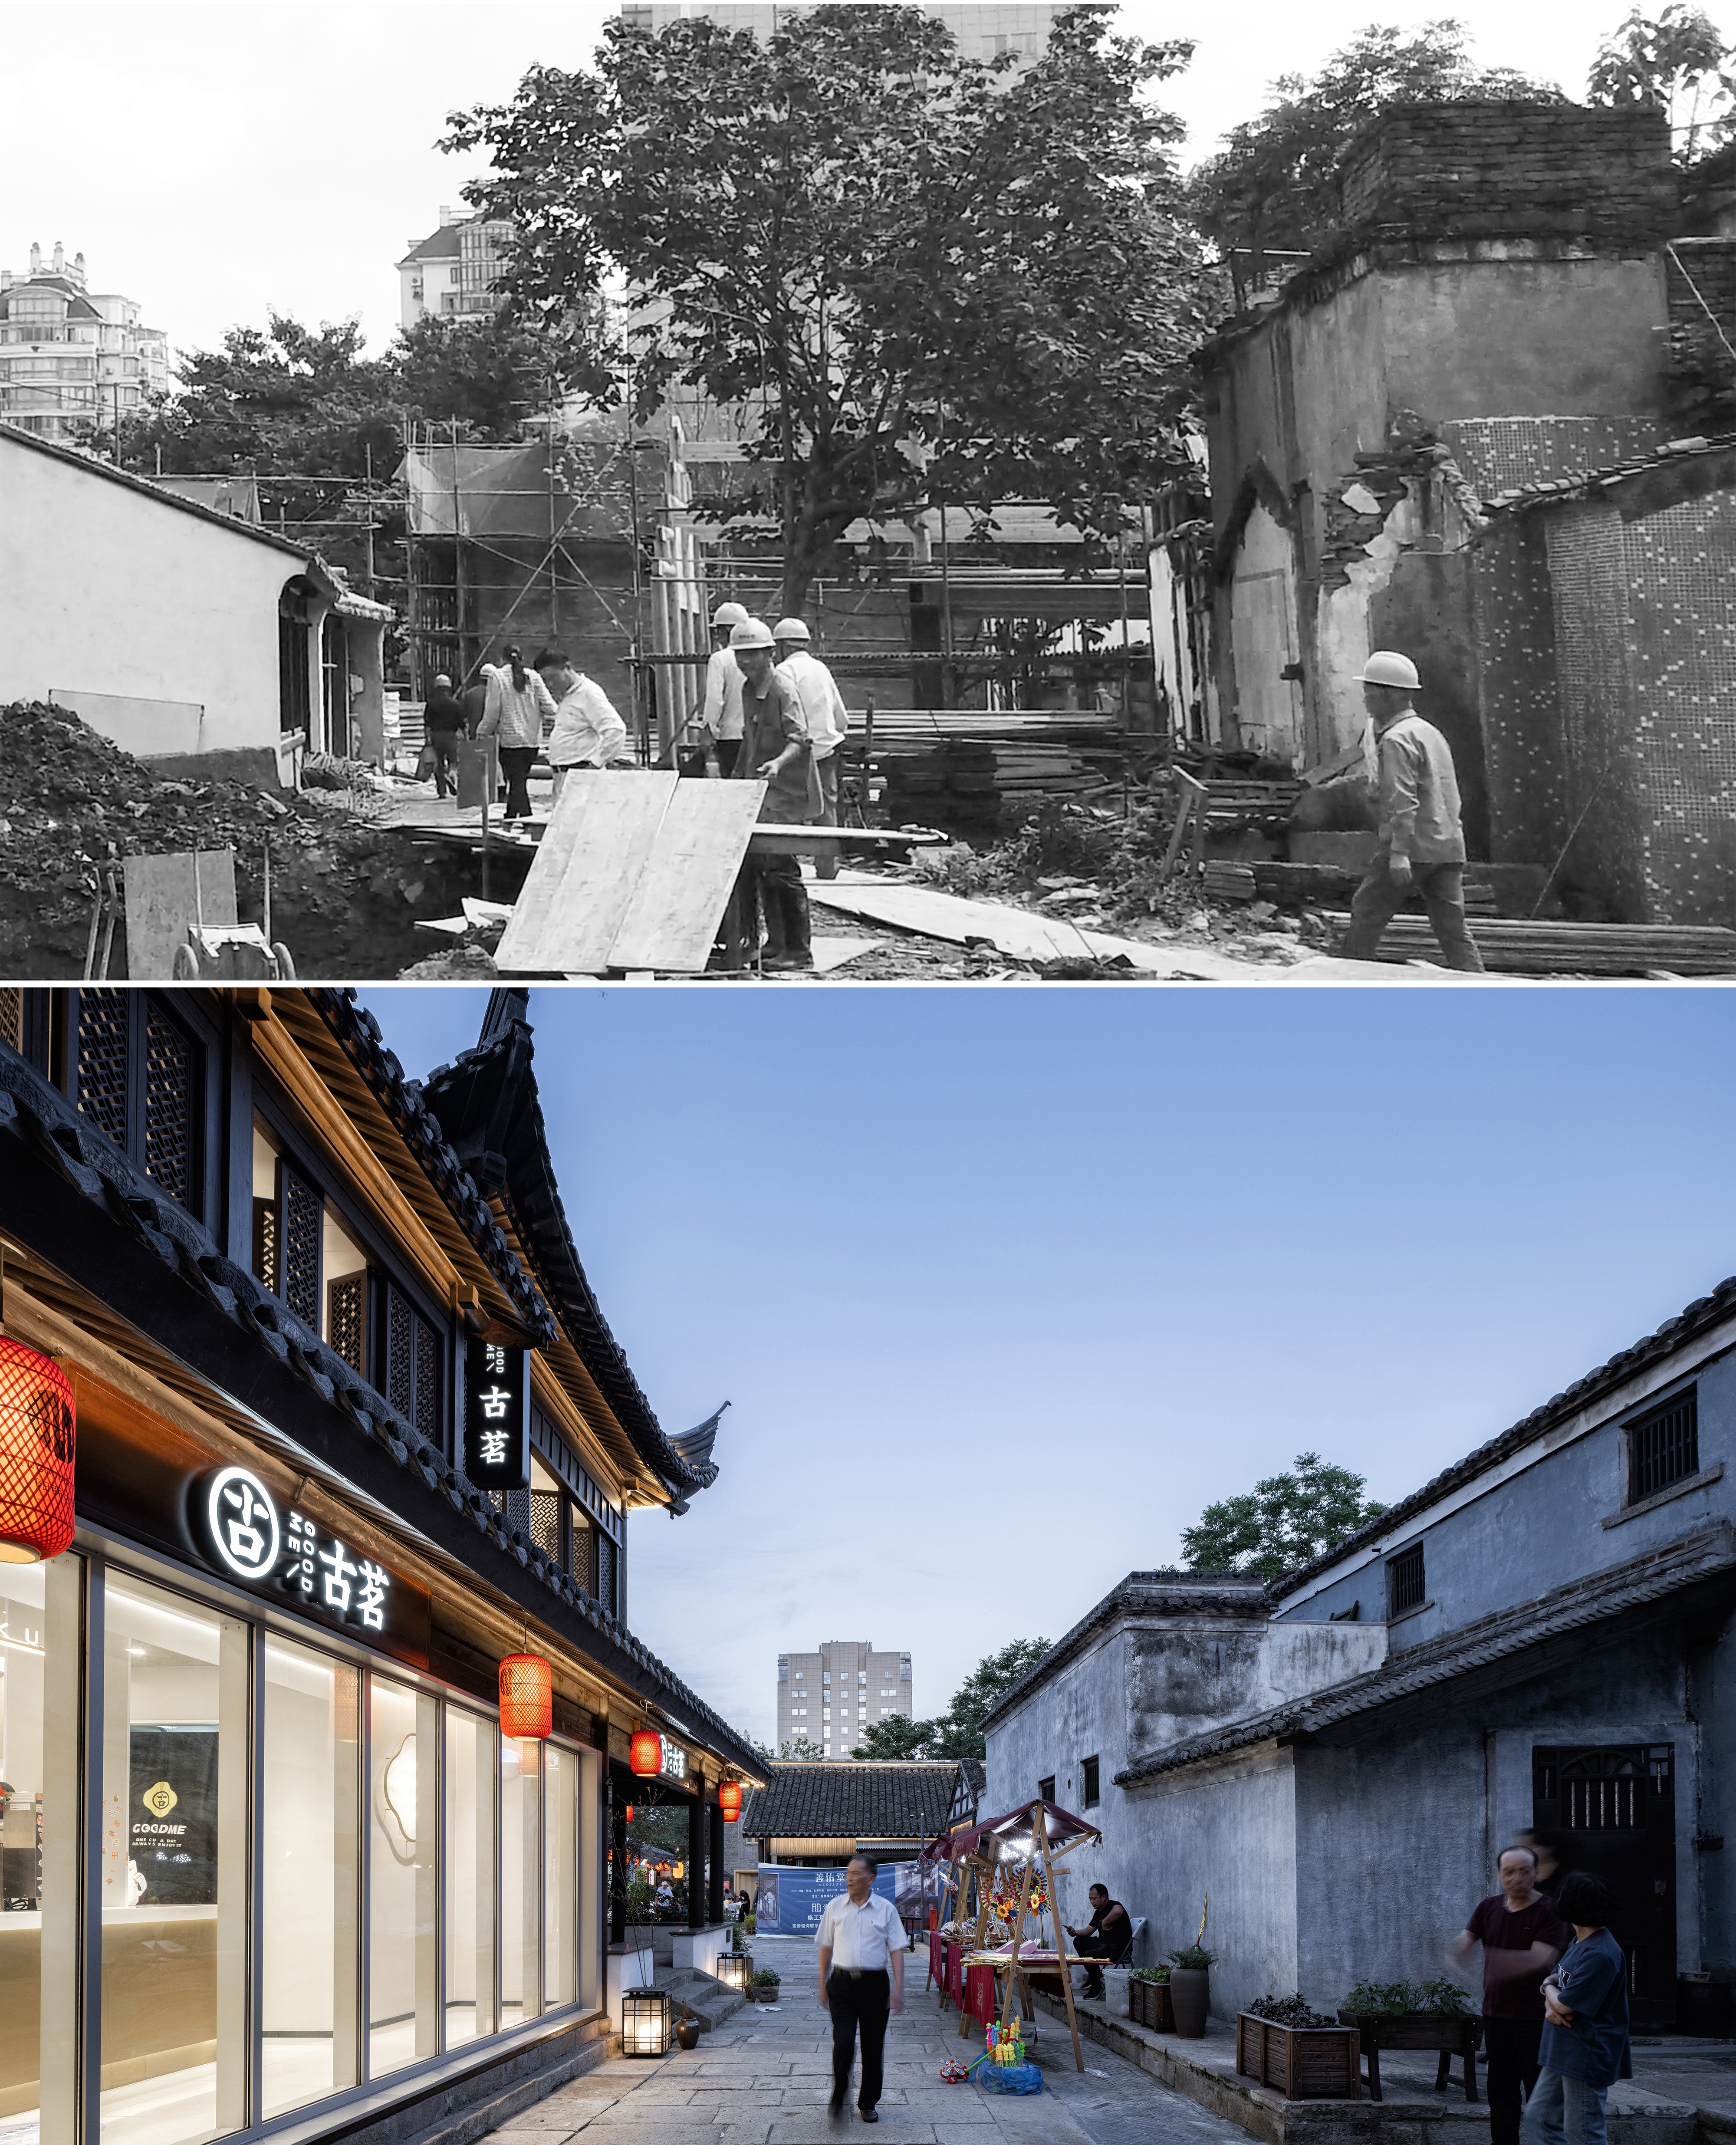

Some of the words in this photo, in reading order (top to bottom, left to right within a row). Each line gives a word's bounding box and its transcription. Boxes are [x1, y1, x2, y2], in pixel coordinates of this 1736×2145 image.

[479, 1385, 511, 1464] 古茗
[301, 1521, 316, 1593] GOOD
[319, 1540, 390, 1630] 古茗
[672, 1747, 684, 1778] 古茗
[815, 1872, 845, 1882] 善佑堂
[812, 1903, 821, 1912] FID
